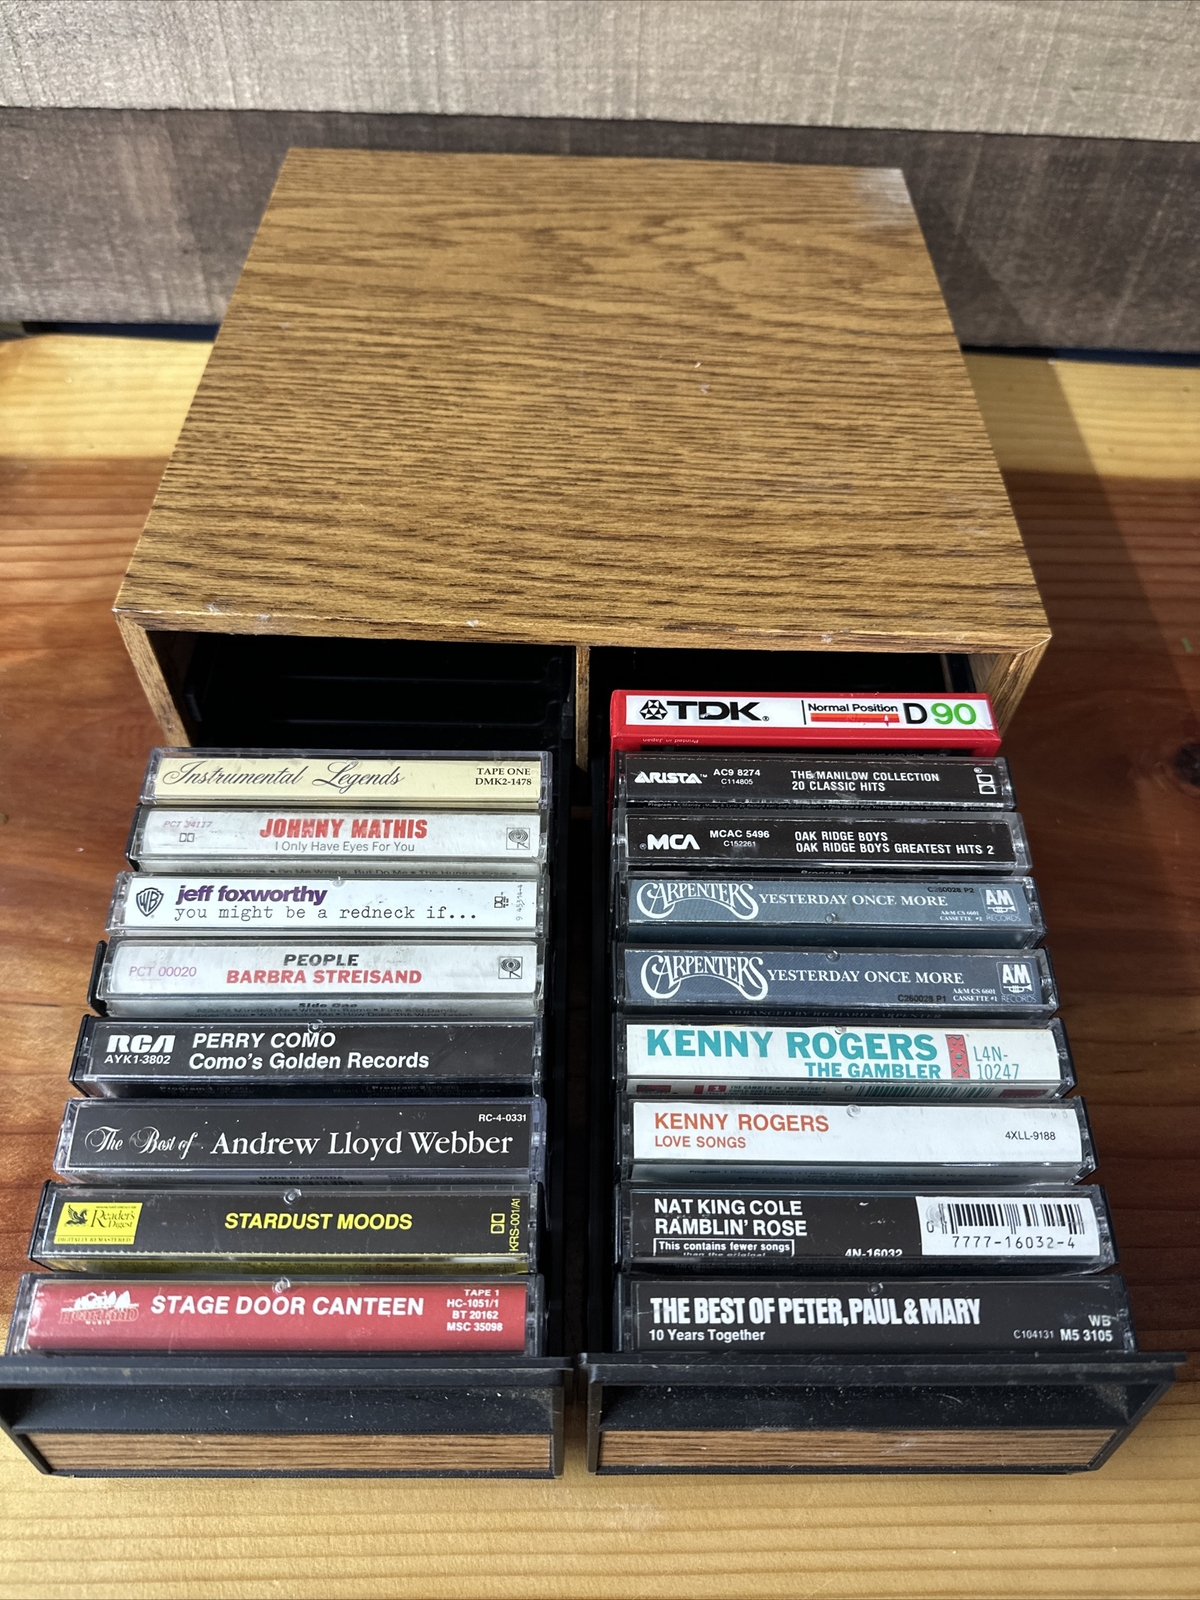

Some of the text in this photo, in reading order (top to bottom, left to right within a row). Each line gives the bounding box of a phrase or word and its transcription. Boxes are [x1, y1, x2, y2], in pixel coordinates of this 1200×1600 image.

[667, 700, 762, 721] TDK
[808, 703, 898, 713] Normal Position
[162, 760, 405, 794] Instrumental Legends
[476, 768, 531, 776] TAPE ONE
[713, 768, 761, 776] AC9 8274
[790, 770, 940, 782] THE MANILOW COLLECTION
[475, 778, 532, 786] DMK2-1478
[792, 781, 886, 792] 20 CLASSIC HITS
[259, 818, 428, 839] JOHNNY MATHIS
[710, 830, 770, 838] MCAC 5496
[647, 834, 700, 850] MCA
[794, 831, 888, 842] OAK RIDGE BOYS
[275, 841, 415, 854] I Only Have Eyes For You
[796, 842, 995, 856] OAK RIDGE BOYS GREATEST HITS 2
[175, 885, 328, 906] jeff foxworthy
[636, 882, 759, 920] CARPENTERS
[758, 893, 948, 906] YESTERDAY ONCE MORE
[174, 906, 476, 922] you might be a redneck if...
[283, 954, 360, 966] PEOPLE
[129, 966, 198, 977] PCT 00020
[226, 970, 422, 984] BARBRA STREISAND
[640, 954, 768, 1000] CARPENTERS
[767, 970, 964, 984] YESTERDAY ONCE MORE
[1001, 994, 1037, 1003] RECORDS
[106, 1034, 176, 1053] RCA
[192, 1032, 336, 1048] PERRY COMO
[646, 1028, 938, 1060] KENNY ROGERS
[104, 1054, 171, 1065] AYK1-3802
[188, 1052, 430, 1070] Como's Golden Records
[973, 1046, 1008, 1062] L4N-
[804, 1062, 942, 1079] THE GAMBLER
[976, 1063, 1020, 1080] 10247
[478, 1114, 527, 1122] RC-4-0331
[654, 1112, 829, 1132] KENNY ROGERS
[654, 1136, 746, 1148] LOVE SONGS
[1004, 1130, 1056, 1141] 4XLL-9188
[84, 1126, 514, 1161] The Best of Andrew Lloyd Webber
[654, 1198, 803, 1216] NAT KING COLE
[90, 1210, 135, 1228] Reader's
[224, 1212, 413, 1230] STARDUST MOODS
[654, 1218, 808, 1236] RAMBLIN' ROSE
[658, 1241, 790, 1253] This contains fewer songs
[464, 1288, 500, 1296] TAPE 1
[150, 1296, 424, 1316] STAGE DOOR CANTEEN
[446, 1299, 500, 1308] HC-1051/1
[452, 1310, 499, 1320] BT 20162
[650, 1298, 691, 1324] THE
[694, 1298, 746, 1324] BEST
[749, 1298, 776, 1324] OF
[903, 1298, 919, 1325] &
[919, 1298, 980, 1325] MARY
[446, 1322, 503, 1332] MSC 35098
[1088, 1314, 1112, 1327] WB
[648, 1328, 766, 1344] 10 Years Together
[1013, 1329, 1114, 1342] C104131 M5 3105
